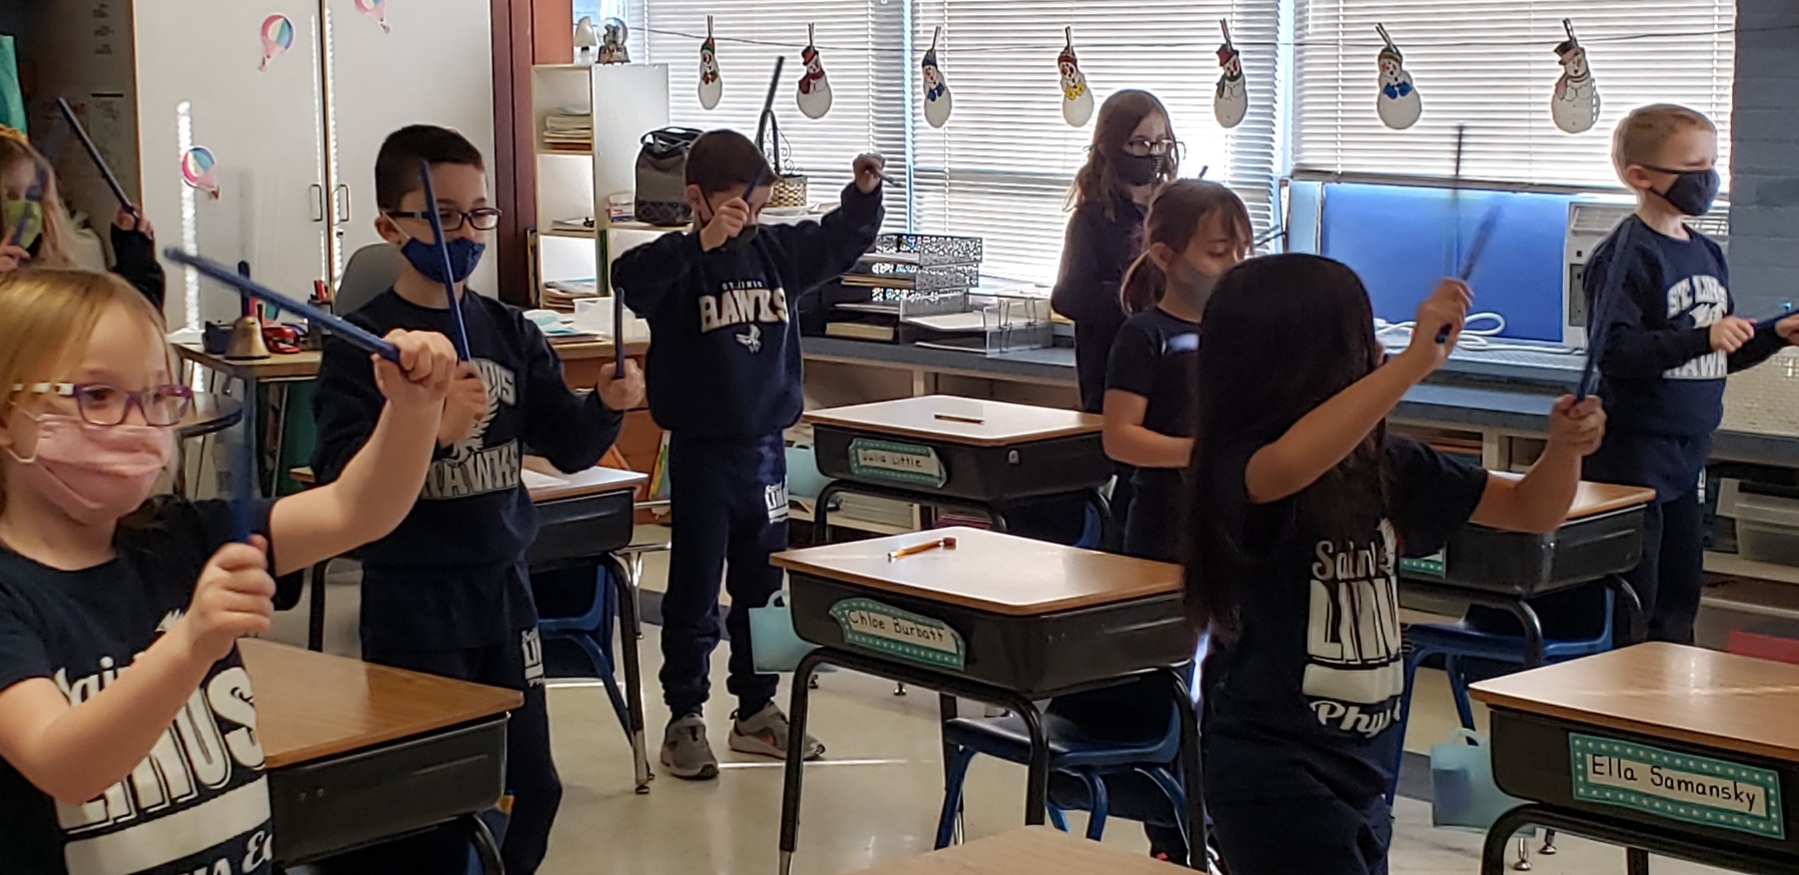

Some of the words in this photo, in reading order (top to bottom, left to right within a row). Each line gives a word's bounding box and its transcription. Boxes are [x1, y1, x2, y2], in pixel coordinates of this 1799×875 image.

[699, 287, 790, 333] HAWKS
[892, 454, 923, 468] Little
[847, 608, 886, 630] Chloe
[1592, 753, 1638, 782] Ella
[1650, 765, 1756, 812] Samansky
